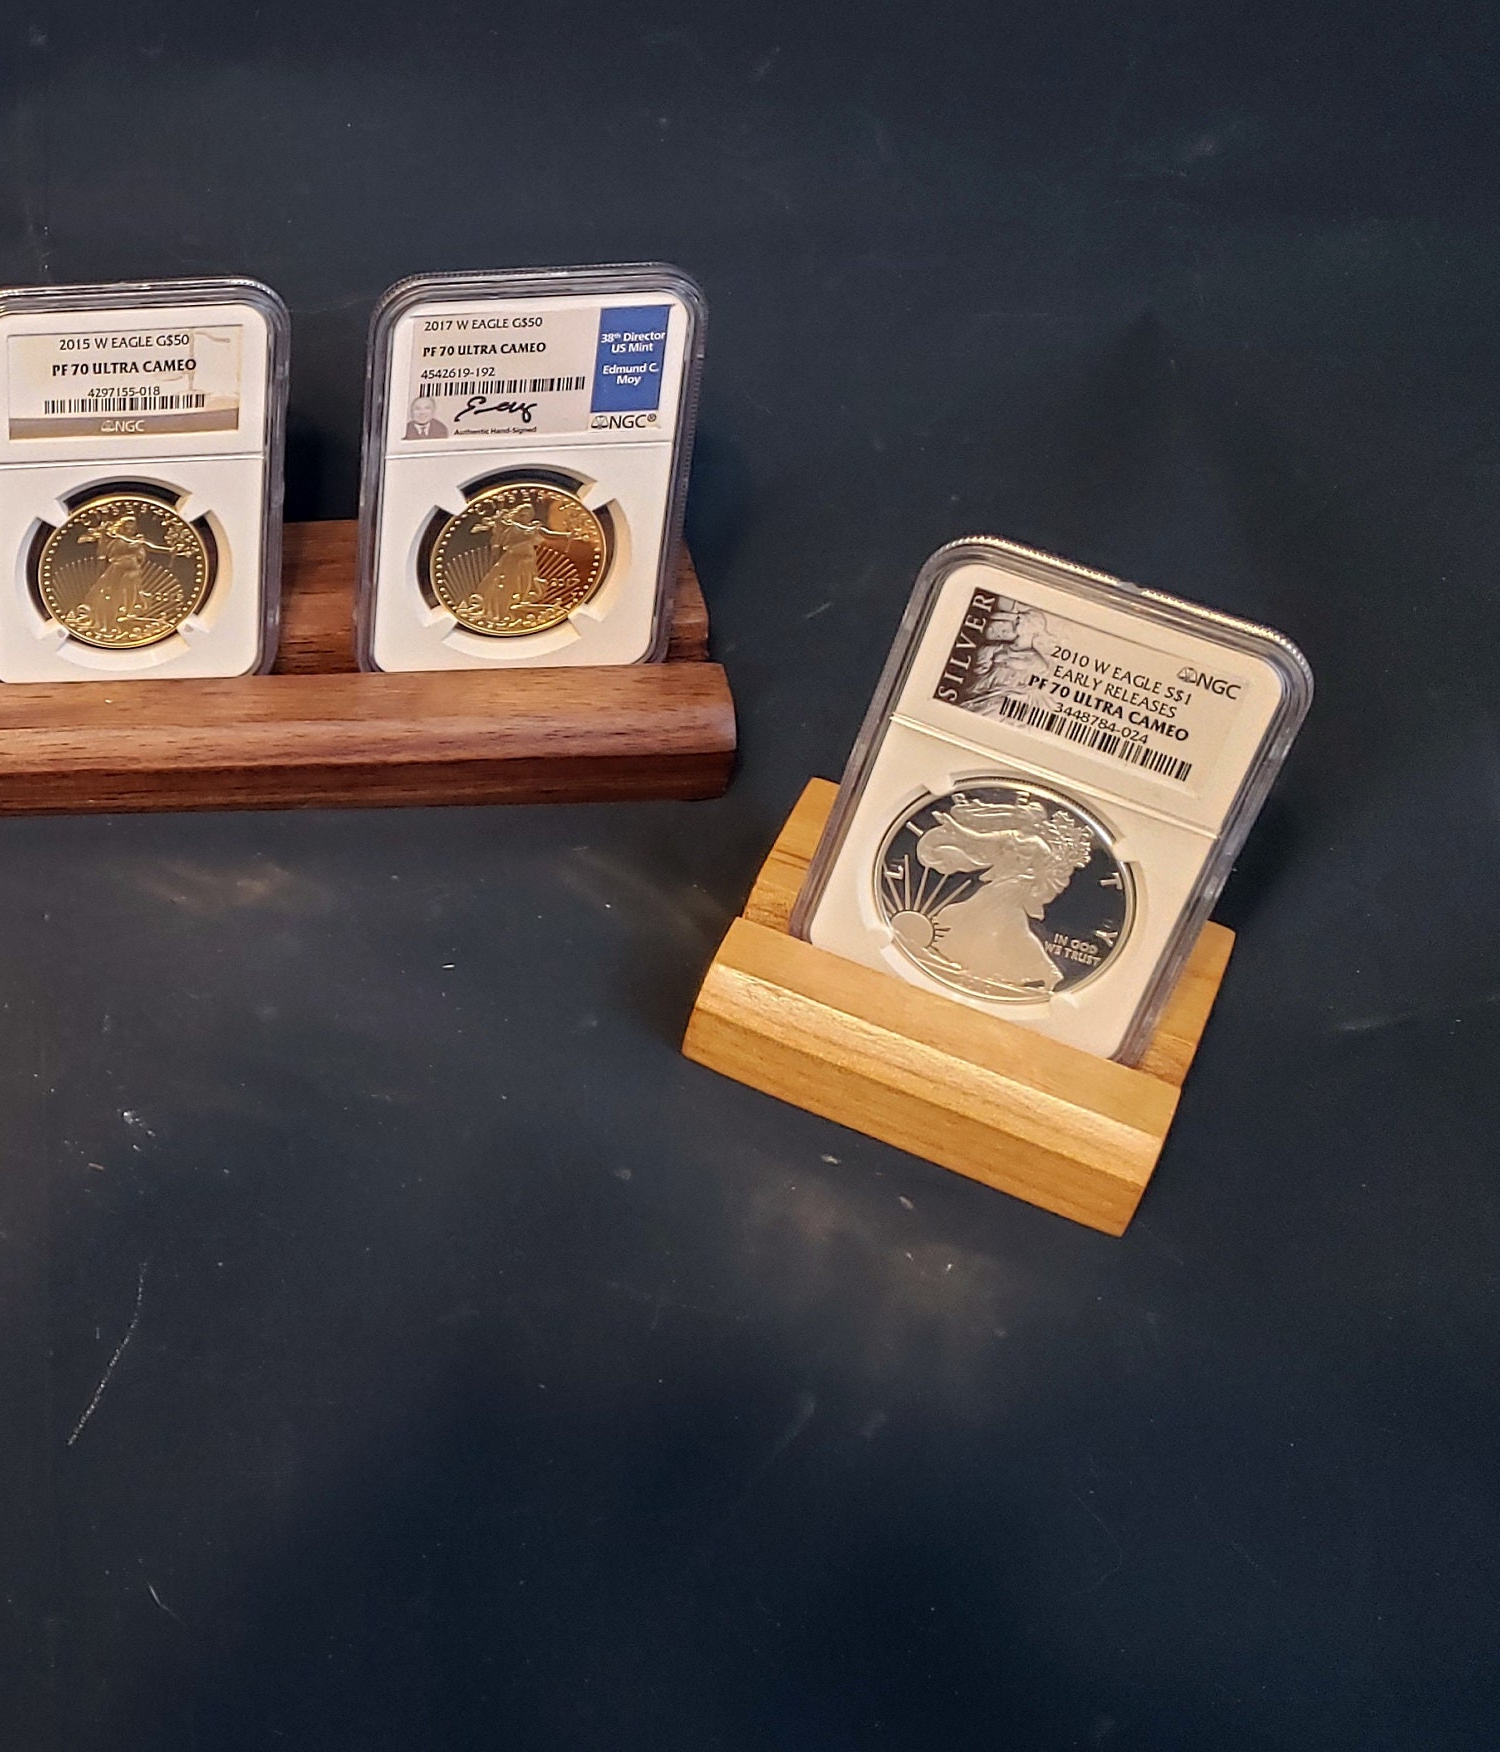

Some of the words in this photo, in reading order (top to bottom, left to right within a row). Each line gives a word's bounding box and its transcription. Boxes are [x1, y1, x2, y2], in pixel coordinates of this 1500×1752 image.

[424, 320, 453, 332] 2017
[457, 319, 469, 330] W
[472, 318, 509, 330] EAGLE
[512, 317, 543, 328] G$50
[59, 339, 90, 351] 2015
[95, 337, 108, 349] W
[111, 336, 153, 348] EAGLE
[156, 334, 190, 346] G$50
[623, 331, 666, 342] Director
[423, 346, 438, 357] PF
[440, 346, 454, 357] 70
[458, 344, 498, 356] ULTRA
[500, 342, 546, 354] CAMEO
[611, 342, 627, 353] US
[628, 341, 653, 352] Mint
[52, 364, 68, 377] PF
[71, 363, 89, 376] 70
[93, 361, 139, 374] ULTRA
[143, 358, 197, 373] CAMEO
[421, 367, 495, 379] 4542619-192
[602, 363, 648, 375] Edmund
[649, 362, 659, 373] C.
[616, 374, 642, 386] Moy
[88, 386, 160, 398] 4297155-018
[115, 420, 145, 433] NGC
[454, 426, 490, 435] Authentic
[938, 593, 996, 702] SILVER
[1050, 645, 1090, 669] 2010
[1094, 659, 1111, 675] W
[1112, 665, 1161, 695] EAGLE
[1164, 685, 1193, 705] S$1
[1052, 665, 1103, 692] EARLY
[1103, 683, 1177, 718] RELEASES
[1196, 672, 1241, 700] NGC
[1027, 674, 1048, 690] PF
[1049, 681, 1070, 698] 70
[1073, 691, 1124, 719] ULTRA
[1128, 711, 1189, 741] CAMEO
[1053, 702, 1149, 744] 3448784-024
